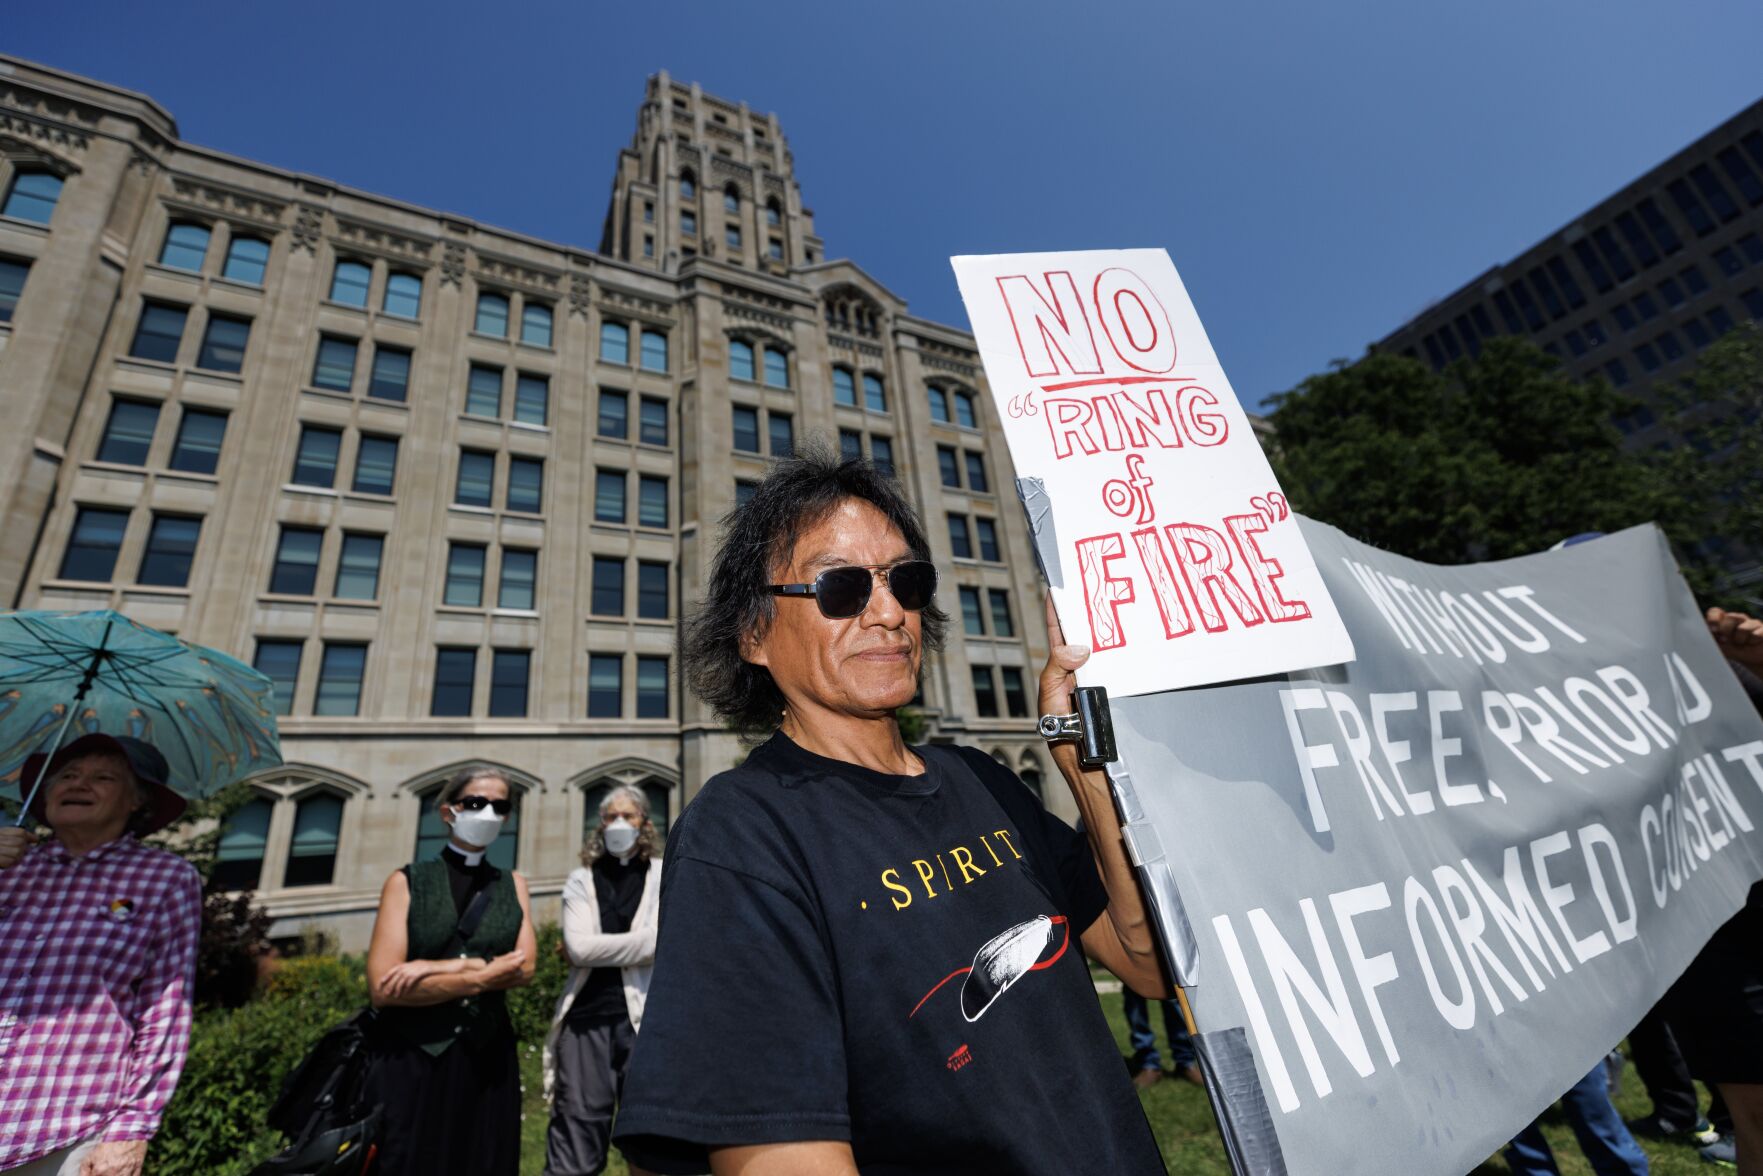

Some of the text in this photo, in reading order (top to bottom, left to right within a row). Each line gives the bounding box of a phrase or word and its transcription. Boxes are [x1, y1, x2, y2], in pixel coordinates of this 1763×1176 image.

[995, 267, 1177, 377] NO
[1102, 454, 1153, 525] of
[1481, 664, 1678, 784] PRIOR
[881, 829, 1022, 911] SPIRIT
[1212, 823, 1638, 1114] INFORMED
